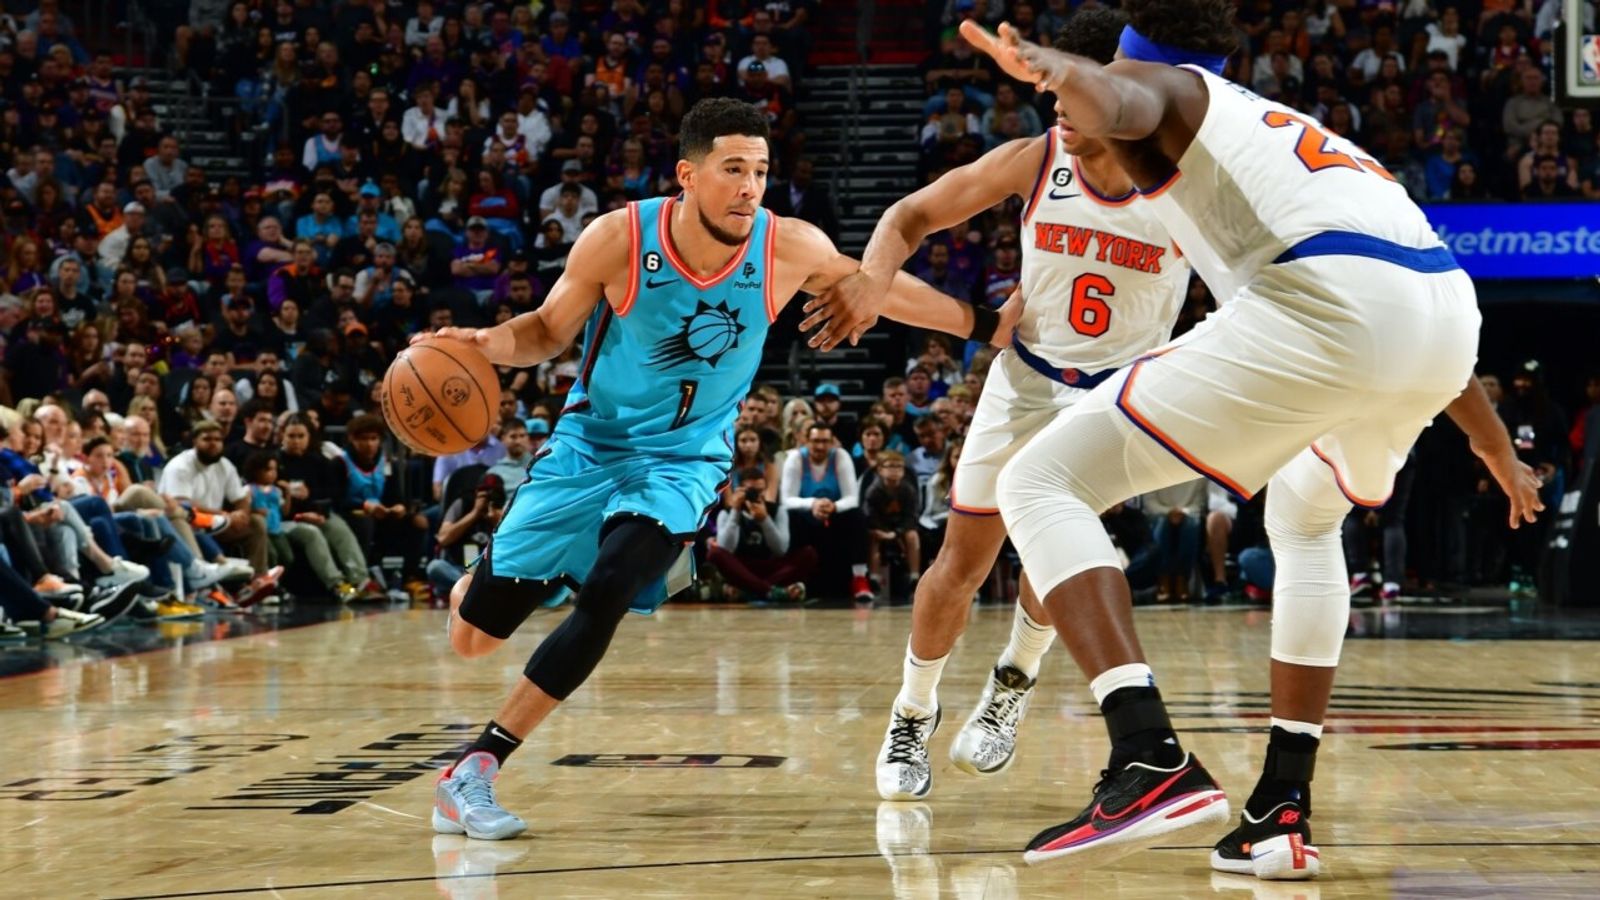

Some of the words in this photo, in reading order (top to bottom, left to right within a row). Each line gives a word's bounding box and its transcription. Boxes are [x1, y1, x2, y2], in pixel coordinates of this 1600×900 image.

[1262, 110, 1398, 183] 2
[1056, 170, 1070, 184] 6
[646, 254, 660, 270] 6
[1034, 221, 1093, 257] NEW
[1095, 232, 1166, 274] YORK
[733, 281, 762, 290] PayPal
[1068, 272, 1115, 338] 6
[668, 379, 698, 430] 1
